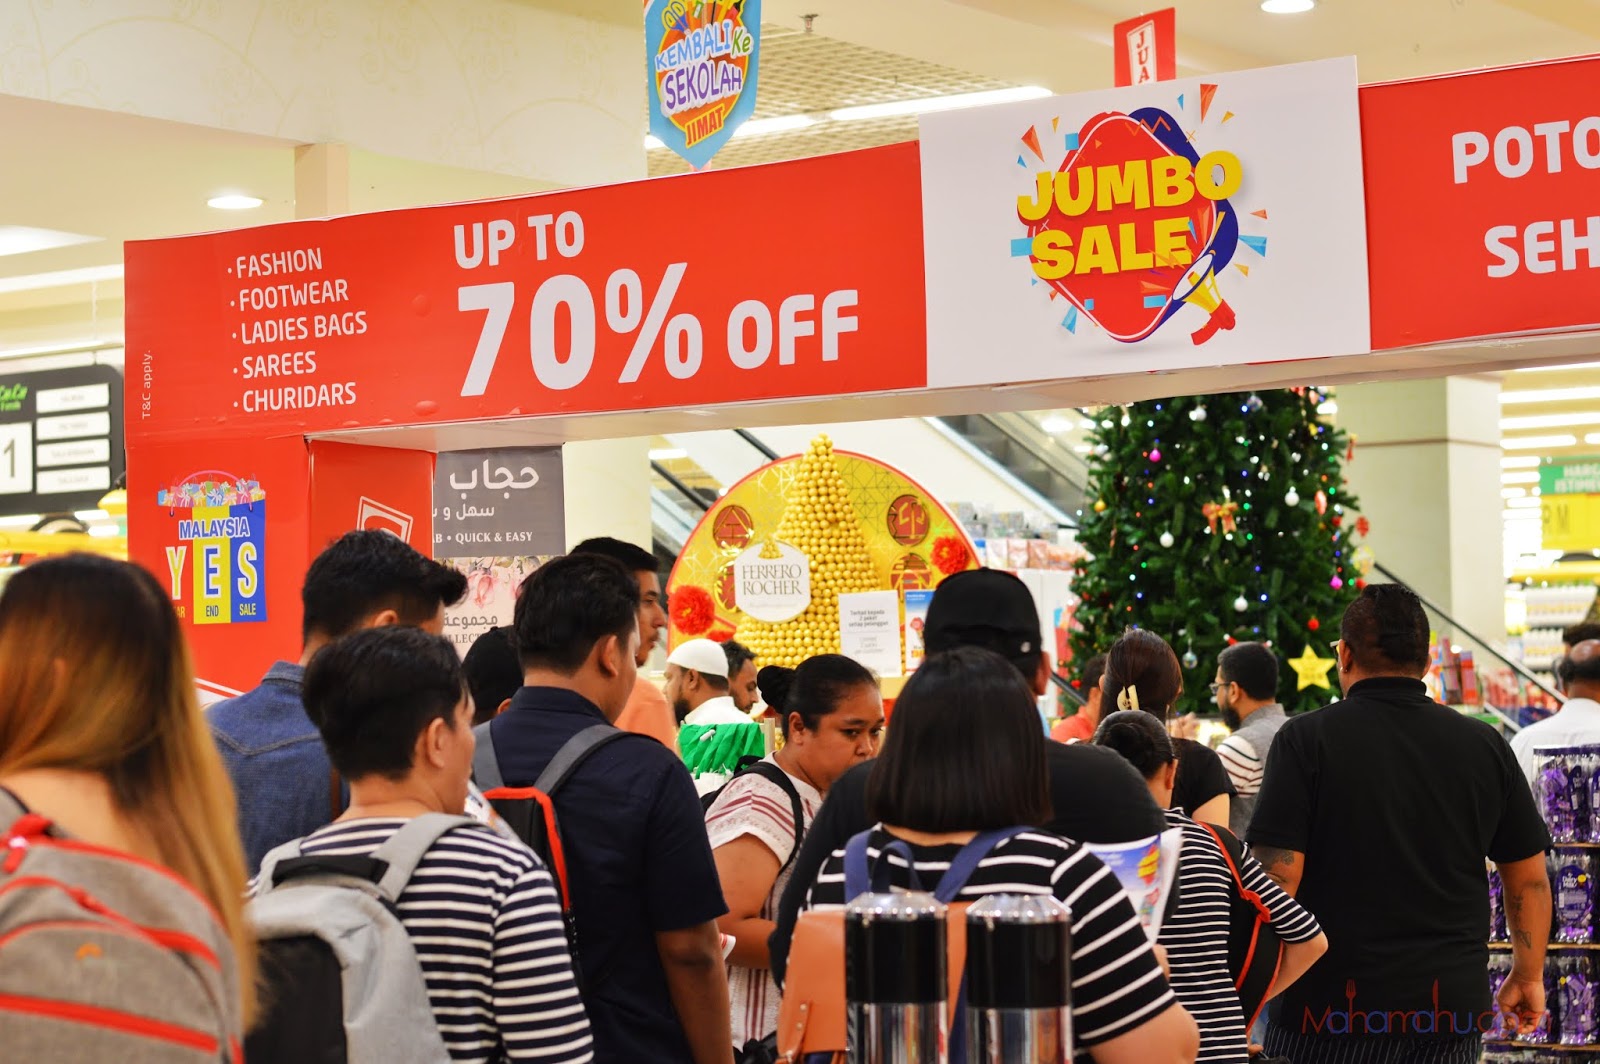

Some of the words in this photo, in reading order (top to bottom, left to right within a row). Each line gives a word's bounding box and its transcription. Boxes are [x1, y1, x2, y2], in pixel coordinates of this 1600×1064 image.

[656, 21, 731, 71] KEMBALI
[731, 28, 751, 56] Ke
[665, 62, 742, 110] SEKOLAH
[686, 107, 724, 147] JIMAT
[1016, 150, 1243, 221] JUMBO
[454, 219, 516, 269] UP
[527, 210, 585, 261] TO
[1031, 216, 1193, 280] SALE
[1484, 216, 1600, 278] SEH
[236, 247, 323, 279] FASHION
[239, 279, 349, 312] FOOTWEAR
[241, 316, 309, 345] LADIES
[314, 311, 368, 338] BAGS
[458, 262, 703, 397] 70%
[727, 289, 859, 370] OFF
[142, 350, 153, 389] apply.
[242, 350, 317, 379] SAREES
[142, 392, 151, 420] T&C
[243, 382, 357, 413] CHURIDARS
[450, 459, 540, 500] حجاب
[179, 516, 251, 540] MALAYSIA
[455, 503, 495, 521] سهل
[455, 532, 492, 545] QUICK
[493, 532, 503, 542] &
[505, 531, 533, 542] EASY
[742, 564, 802, 580] FERRERO
[742, 580, 803, 596] ROCHER
[174, 606, 186, 619] AR
[205, 605, 219, 617] END
[239, 603, 256, 616] SALE
